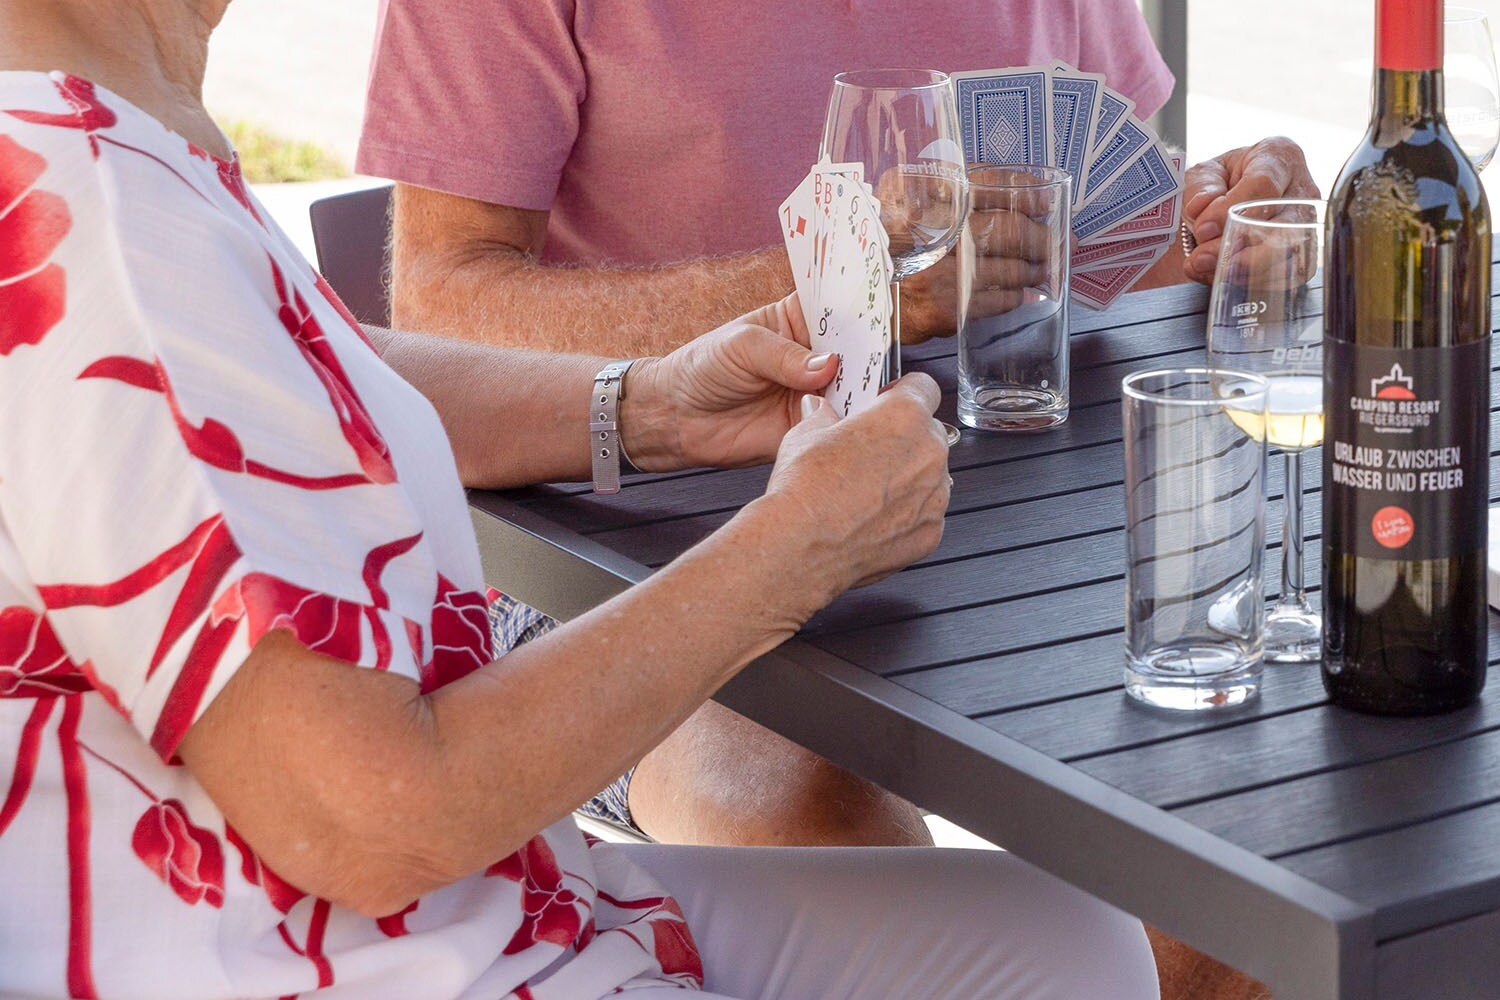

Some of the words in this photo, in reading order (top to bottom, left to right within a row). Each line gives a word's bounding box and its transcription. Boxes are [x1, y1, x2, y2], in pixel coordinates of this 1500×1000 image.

[851, 195, 860, 215] 6
[1350, 396, 1396, 414] CAMPING
[1399, 400, 1440, 415] RESORT
[1359, 411, 1430, 428] RIEGERSBURG
[1334, 440, 1383, 468] URLAUB
[1386, 445, 1461, 469] ZWISCHEN
[1332, 462, 1382, 490] WASSER
[1386, 472, 1416, 492] UND
[1420, 468, 1463, 491] FEUER
